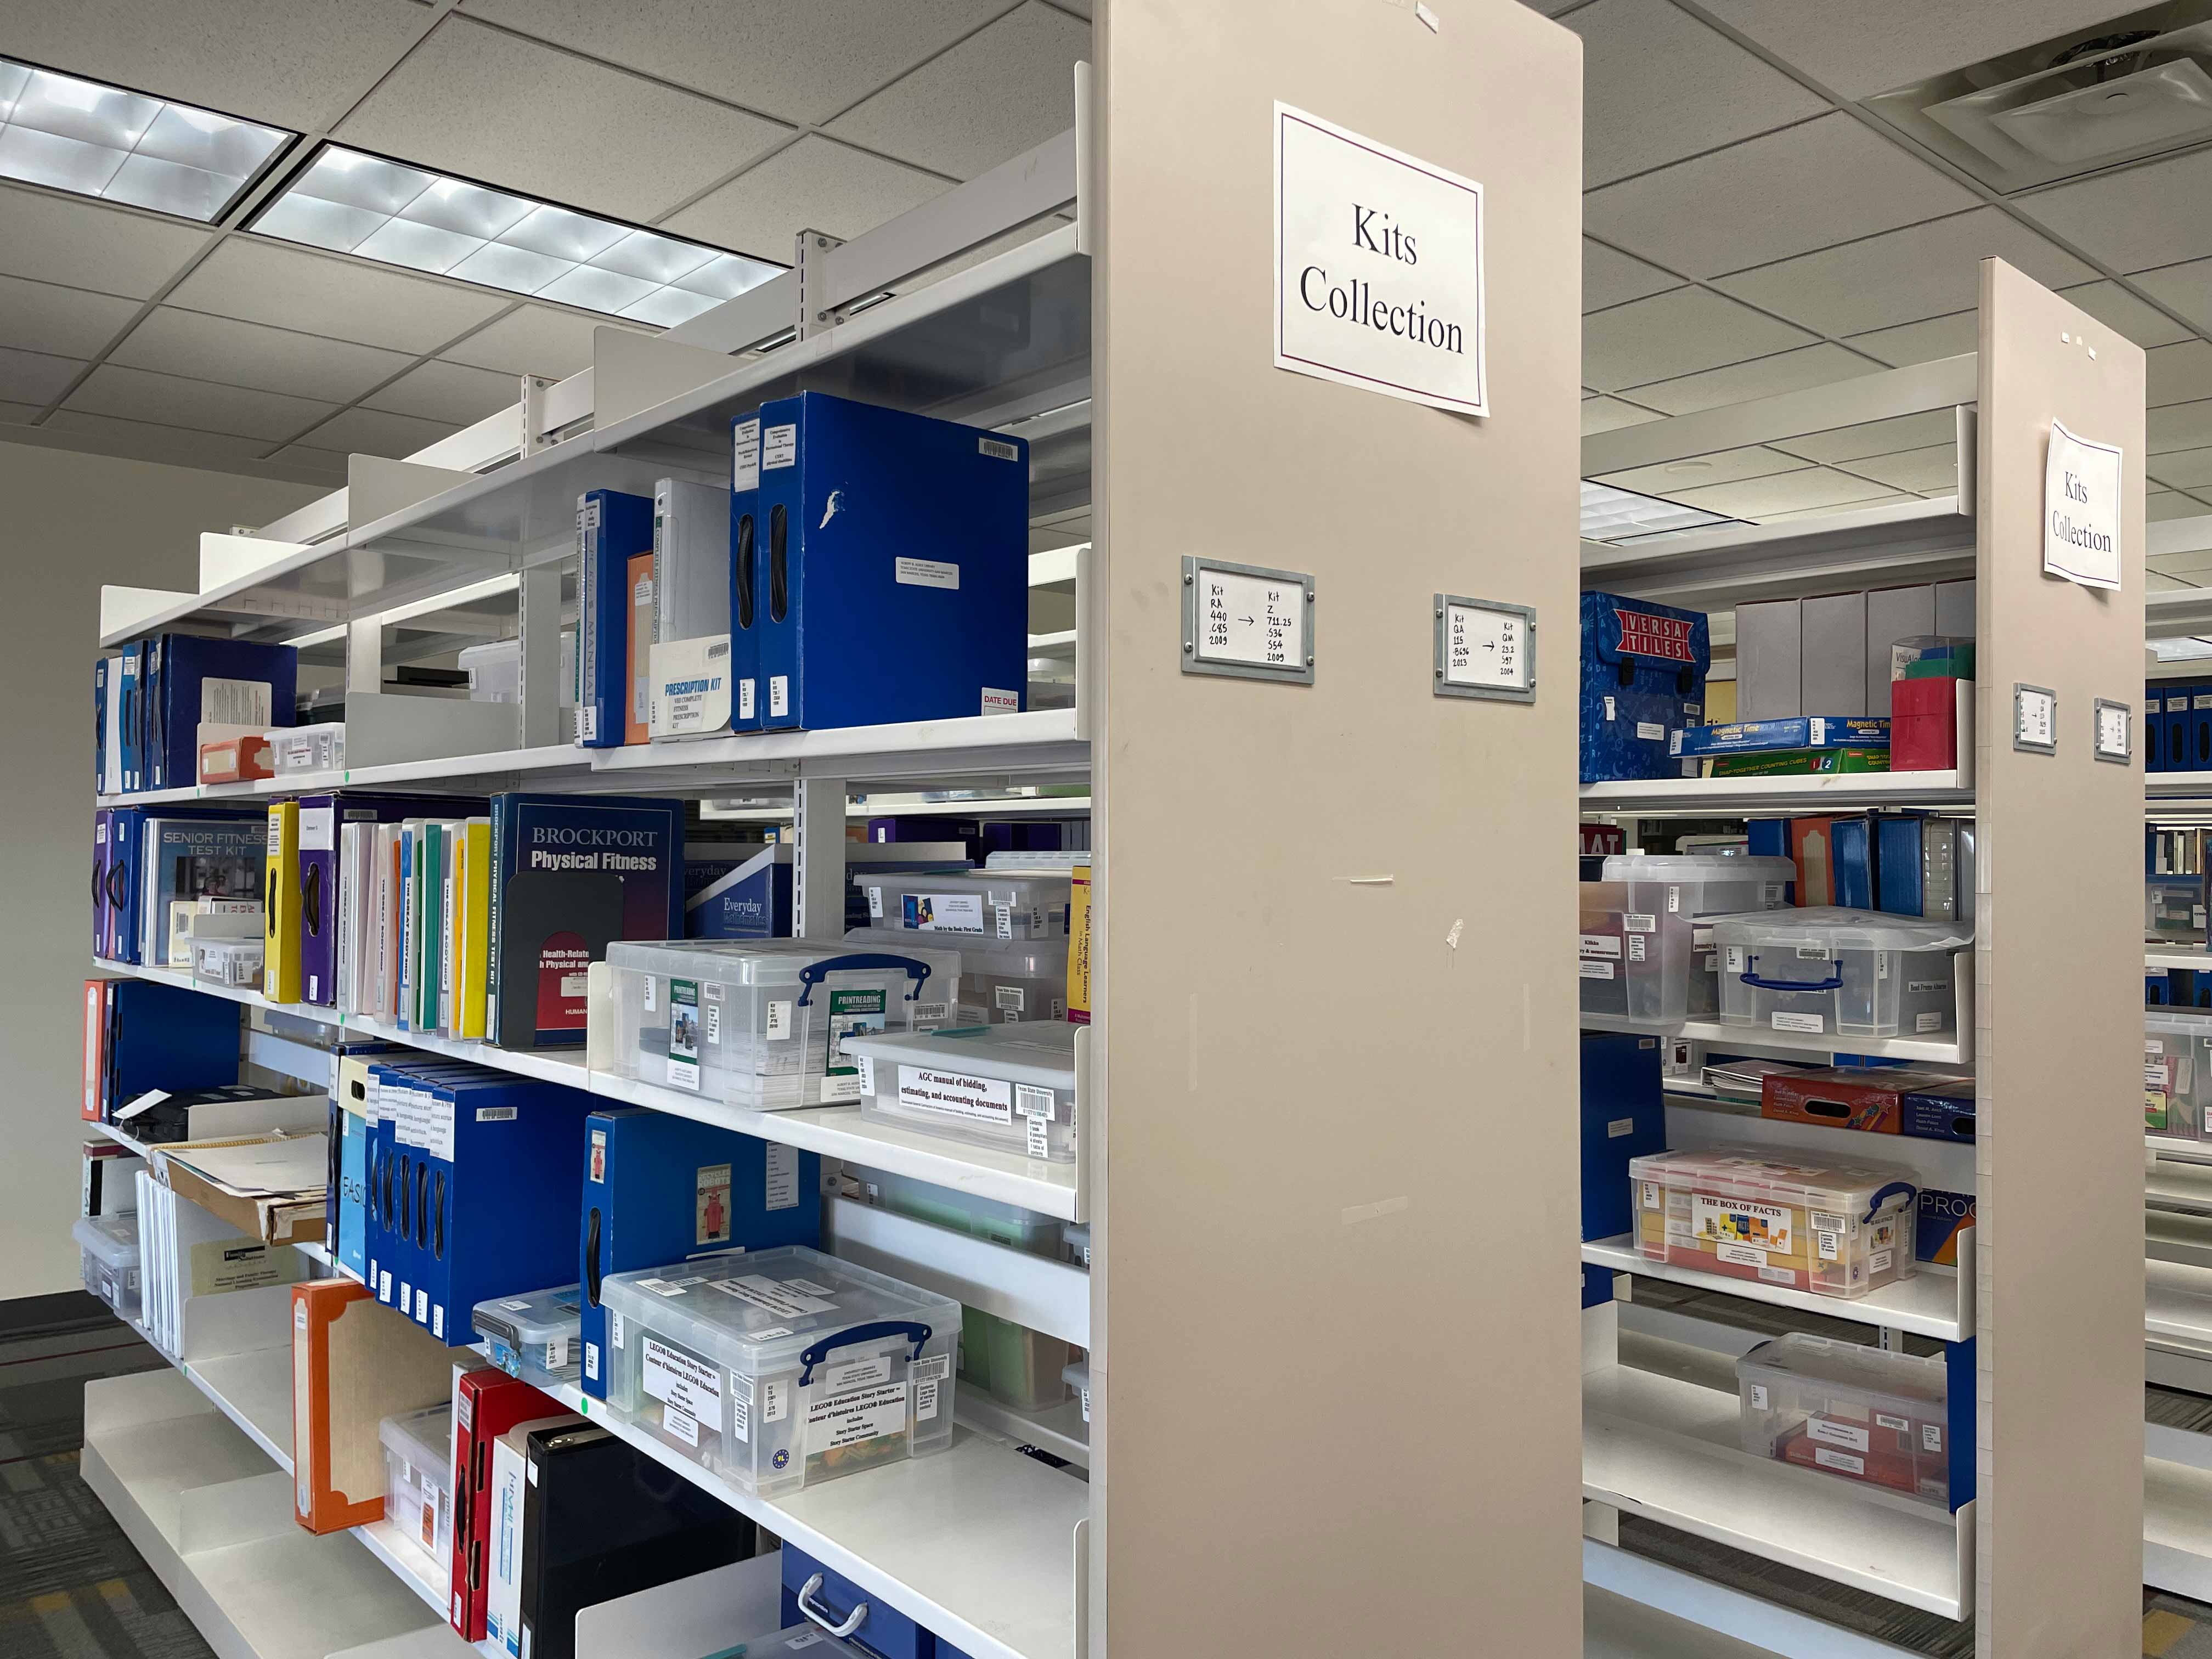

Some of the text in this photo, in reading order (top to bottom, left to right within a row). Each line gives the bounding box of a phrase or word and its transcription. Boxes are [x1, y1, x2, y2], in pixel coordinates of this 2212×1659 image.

[1352, 203, 1417, 266] Kits
[1300, 266, 1464, 354] Collection
[2065, 471, 2087, 504] Kits
[2053, 511, 2112, 552] Collection
[1212, 584, 1223, 595] Kit
[1268, 591, 1279, 601] Kit
[1211, 599, 1222, 608] RA
[1211, 610, 1227, 622] 440
[1267, 617, 1291, 626] 711.25
[1455, 614, 1464, 623] Kit
[1454, 625, 1464, 633] QA
[1628, 614, 1681, 638] VERSA
[1209, 636, 1227, 645] 2009
[1454, 636, 1463, 645] 115
[1503, 634, 1514, 642] QM
[1630, 636, 1681, 657] TILES
[1267, 653, 1284, 662] 2009
[665, 678, 721, 696] PRESCRIPTION KIT
[681, 695, 702, 703] COMPLETE
[984, 695, 1017, 706] DATE DUE
[673, 712, 699, 720] PRESCRIPTION
[1847, 720, 1891, 729] Magnetic Tim
[1712, 726, 1741, 735] Magnetic
[164, 832, 267, 845] SENIOR FITNESS
[532, 827, 658, 847] BROCKPORT
[188, 845, 246, 856] TEST KIT
[531, 850, 657, 871] Physical Fitness
[684, 865, 727, 878] veryday
[724, 897, 762, 915] Everyday
[723, 912, 768, 928] Mathematics
[546, 960, 575, 969] Physical
[838, 995, 881, 1005] PRINTREADING
[918, 1072, 932, 1081] AGC
[934, 1075, 954, 1085] manual
[963, 1079, 987, 1092] bidding,
[1036, 1088, 1052, 1097] University
[901, 1086, 1007, 1111] estimating, and accounting documents
[1701, 1198, 1781, 1217] THE BOX OF FACTS
[667, 1350, 686, 1365] Education
[687, 1359, 697, 1373] Story
[698, 1365, 712, 1379] Starter
[700, 1380, 719, 1397] Education
[810, 1401, 833, 1412] LEGO®
[834, 1396, 860, 1406] Education
[861, 1392, 875, 1401] Story
[856, 1402, 878, 1412] LEGO®
[879, 1396, 905, 1407] Education
[847, 1415, 863, 1424] includes
[856, 1430, 879, 1441] Community
